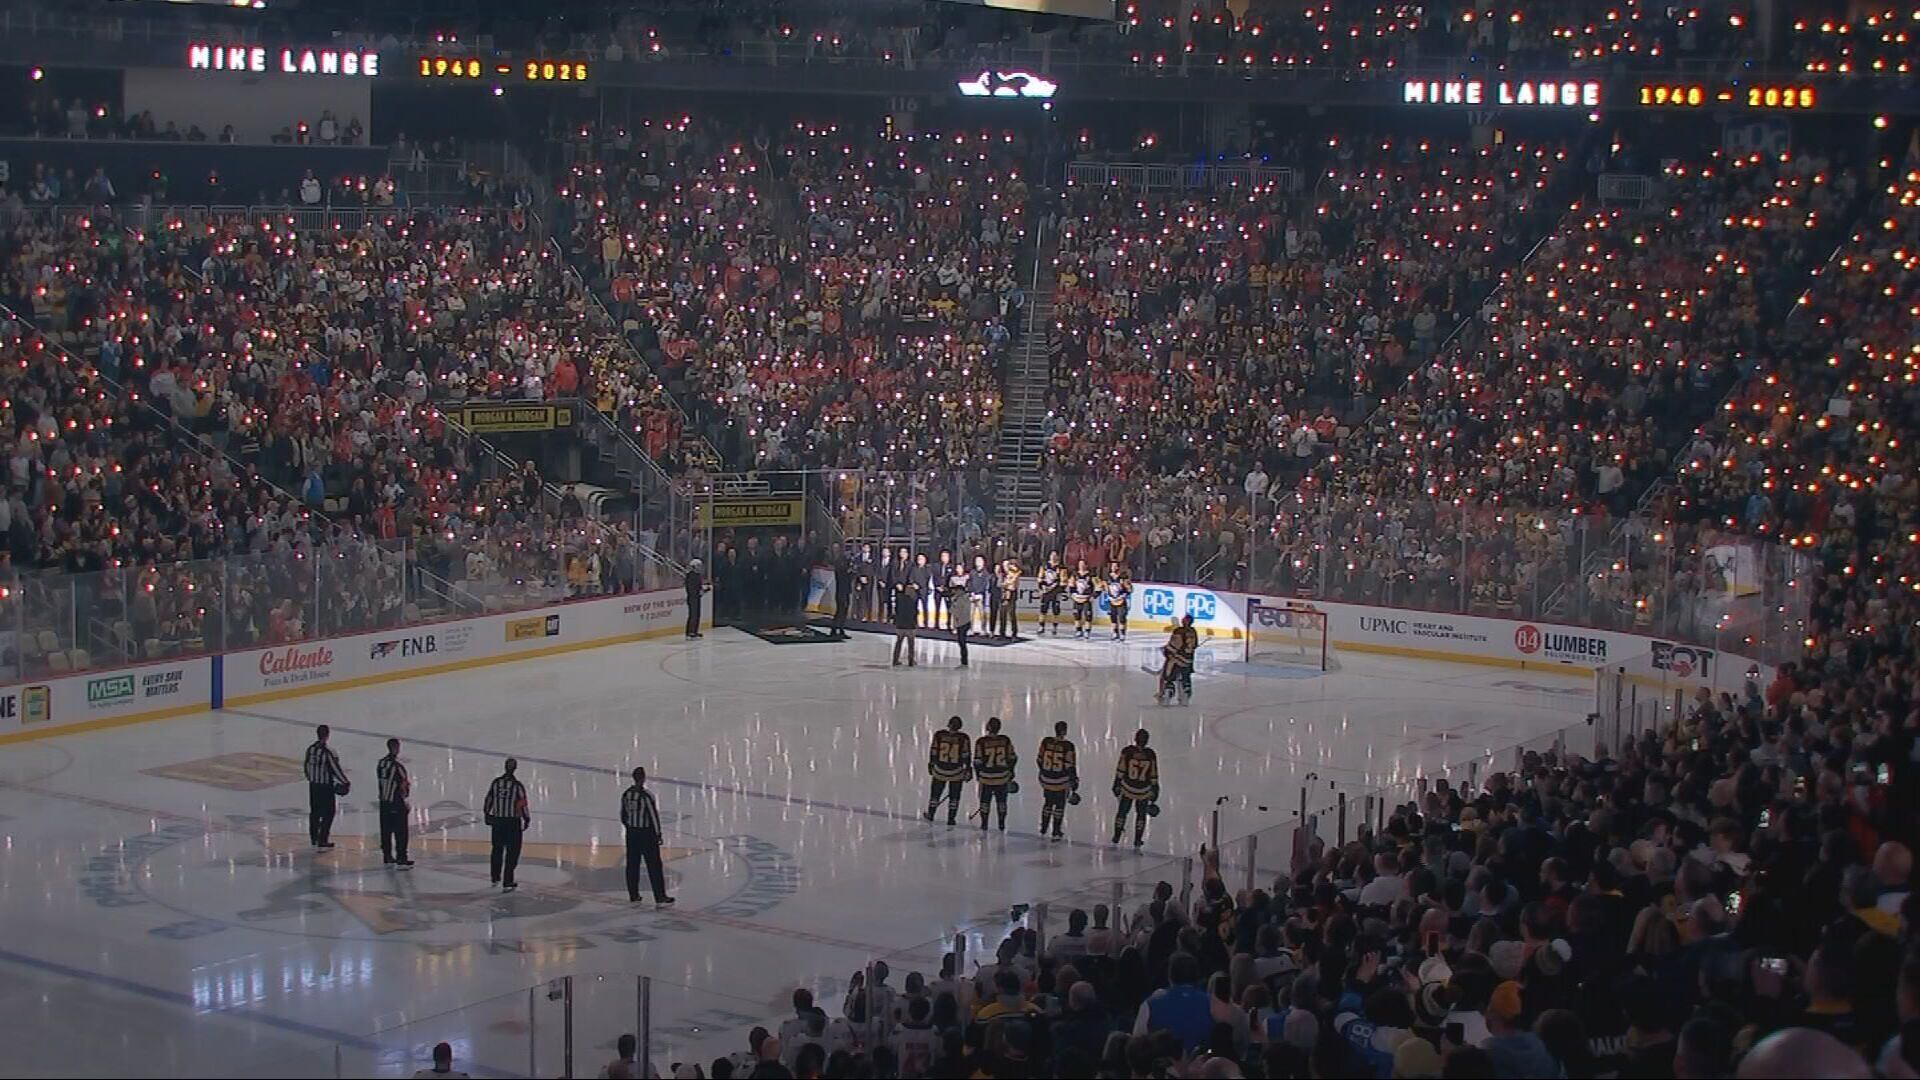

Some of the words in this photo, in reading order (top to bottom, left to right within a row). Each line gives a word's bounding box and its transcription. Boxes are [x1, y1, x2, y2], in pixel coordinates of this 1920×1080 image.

[189, 44, 266, 72] MIKE
[282, 49, 379, 76] LANGE
[419, 58, 481, 78] 1948
[526, 61, 588, 81] 2025
[1404, 81, 1483, 104] MIKE
[1499, 82, 1600, 106] LANGE
[1640, 86, 1704, 106] 1948
[1748, 87, 1817, 108] 2025
[514, 410, 546, 422] MORGAN
[755, 503, 788, 517] MORGAN
[1144, 589, 1174, 613] PPG
[1186, 593, 1216, 619] PPG
[1359, 616, 1408, 635] UPMC
[1412, 622, 1437, 631] HEART
[1438, 624, 1454, 632] AND
[1412, 630, 1450, 639] VASCULAR
[402, 635, 438, 657] F.N.B.
[1516, 631, 1539, 650] 84
[1544, 632, 1608, 657] LUMBER
[259, 646, 334, 676] Caliente
[1651, 640, 1714, 678] EQT
[89, 676, 134, 701] MSA
[142, 673, 165, 687] EVERY
[165, 669, 184, 682] SAVE
[984, 746, 1008, 768] 72
[1043, 750, 1064, 771] 65
[1128, 758, 1152, 781] 67
